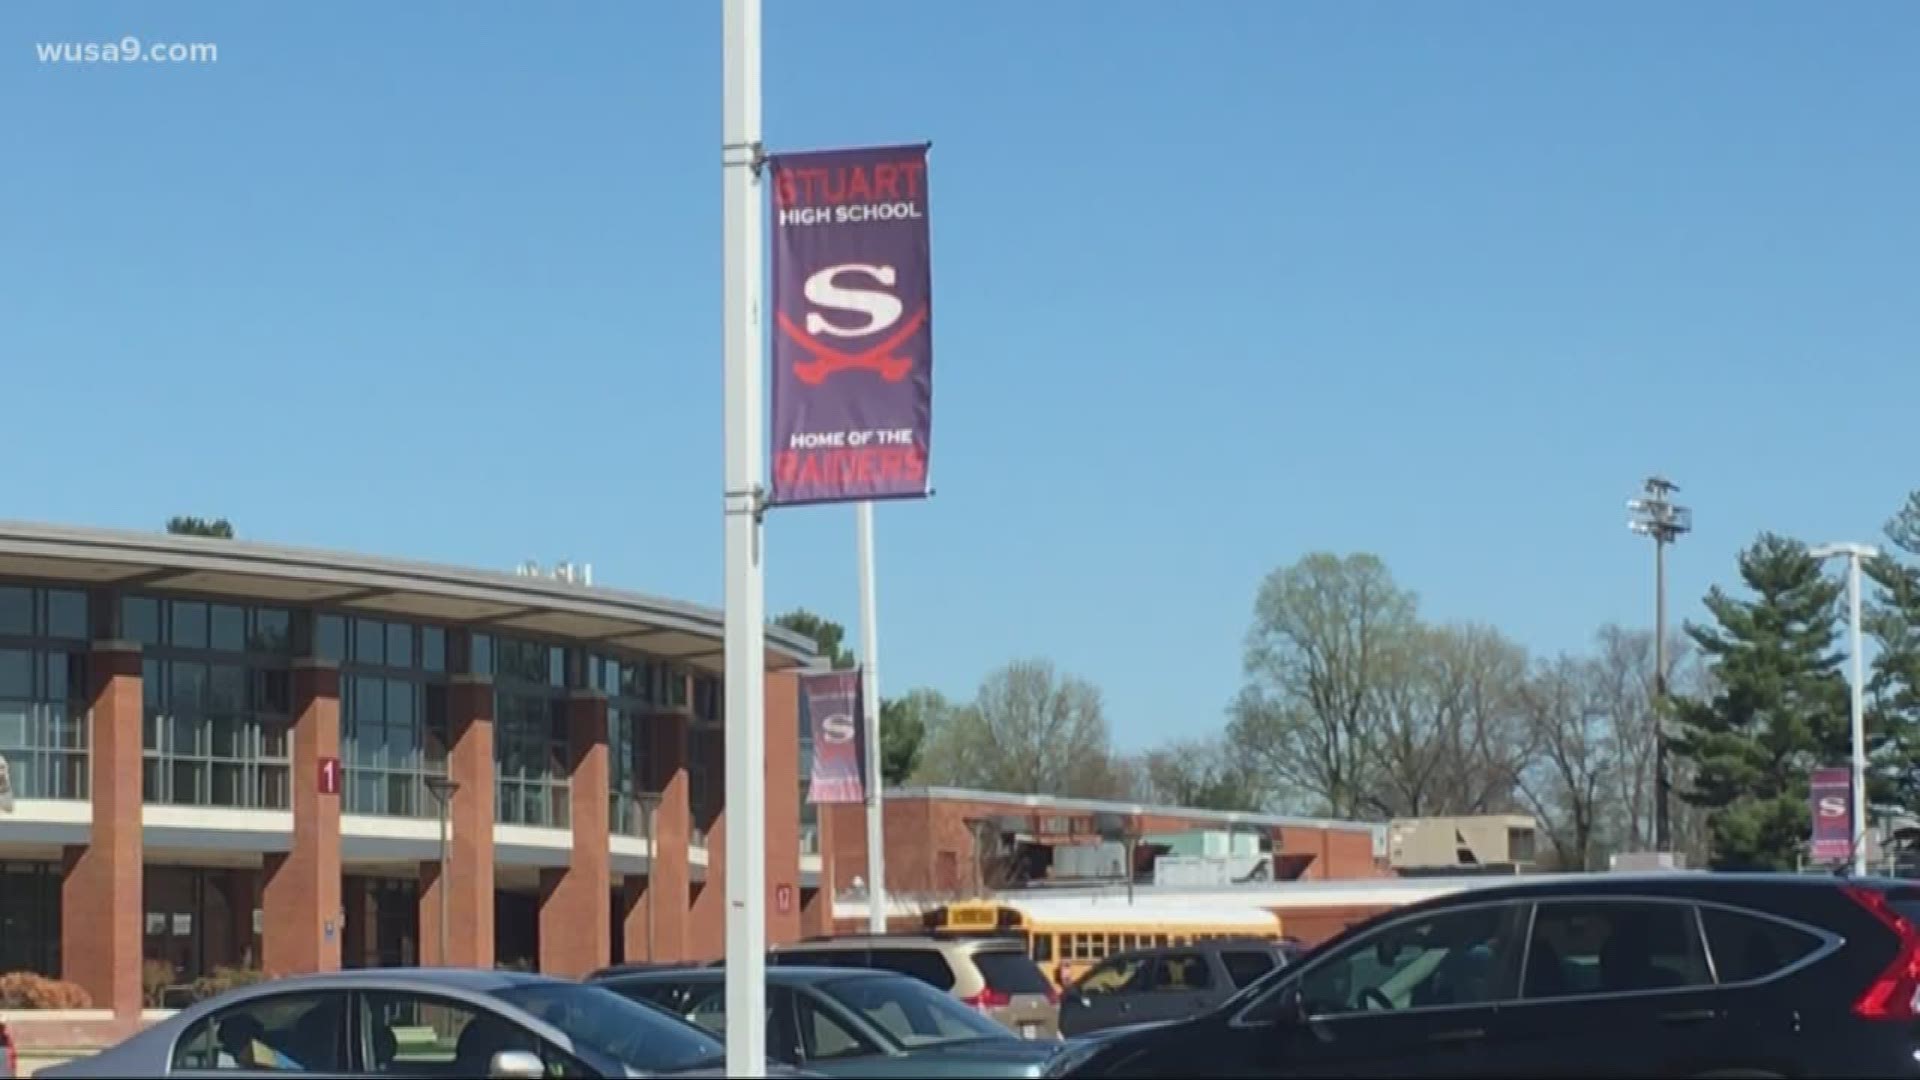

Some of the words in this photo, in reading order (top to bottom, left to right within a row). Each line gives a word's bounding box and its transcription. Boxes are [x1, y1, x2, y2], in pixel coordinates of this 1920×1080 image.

[777, 159, 924, 206] STUART
[779, 206, 831, 226] HIGH
[835, 202, 922, 222] SCHOOL
[804, 264, 903, 337] S
[790, 432, 844, 448] HOME
[848, 430, 875, 445] OF
[876, 428, 913, 444] THE
[822, 714, 856, 744] S
[323, 760, 334, 793] 1
[1819, 797, 1846, 817] S
